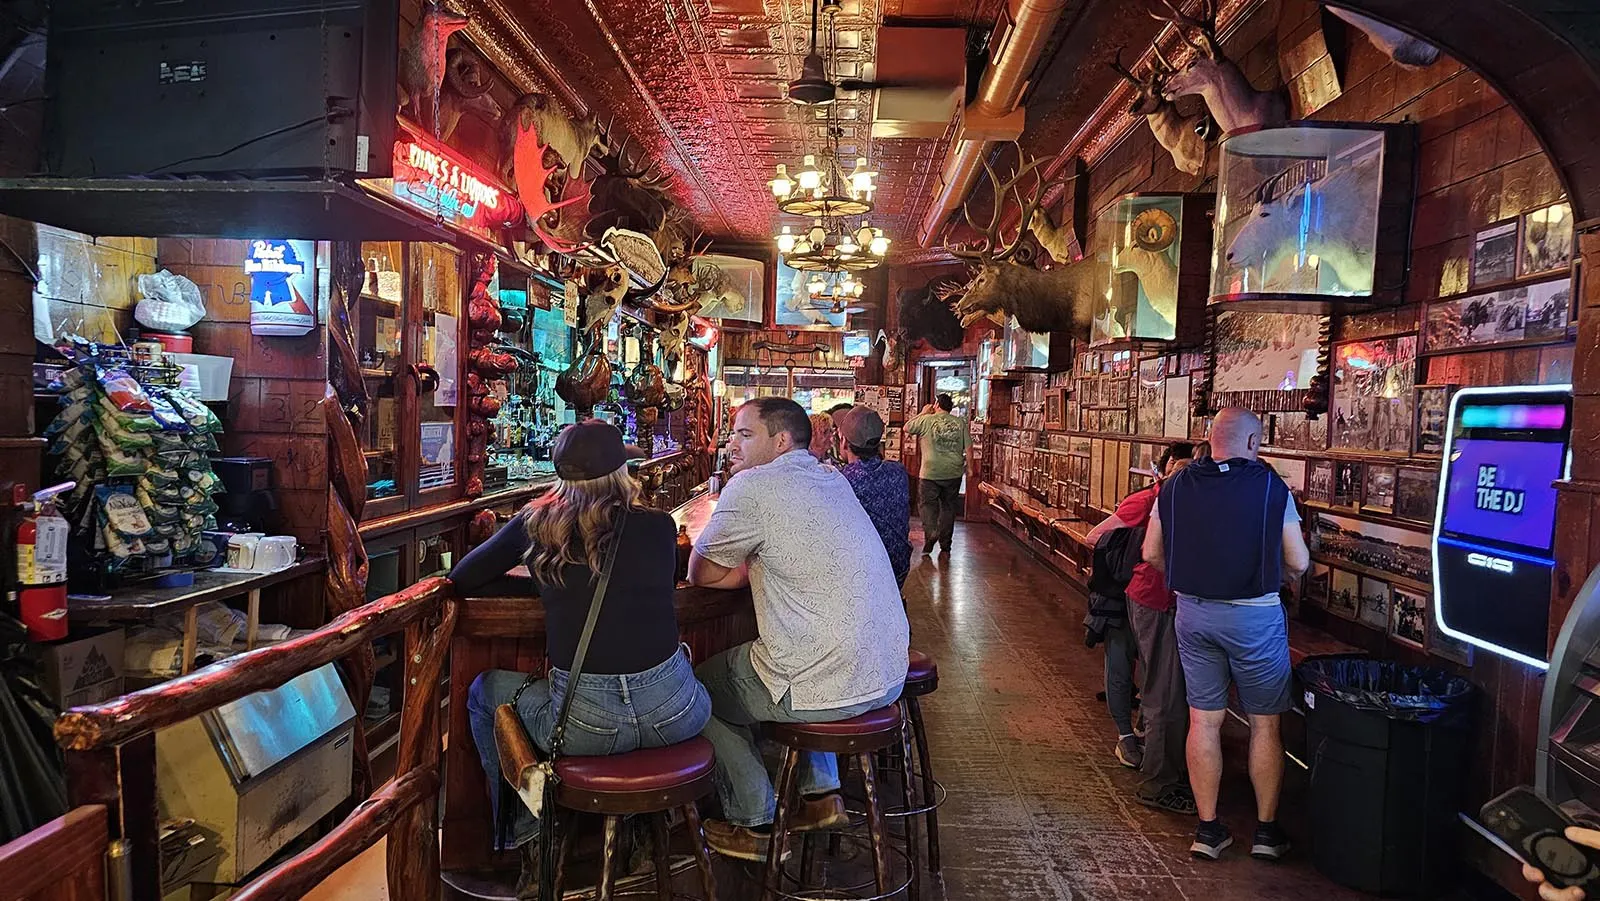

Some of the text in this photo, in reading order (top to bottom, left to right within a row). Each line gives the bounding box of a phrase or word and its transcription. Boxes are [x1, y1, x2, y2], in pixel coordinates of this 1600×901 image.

[1477, 466, 1498, 487] BE
[1476, 488, 1525, 513] THE DJ
